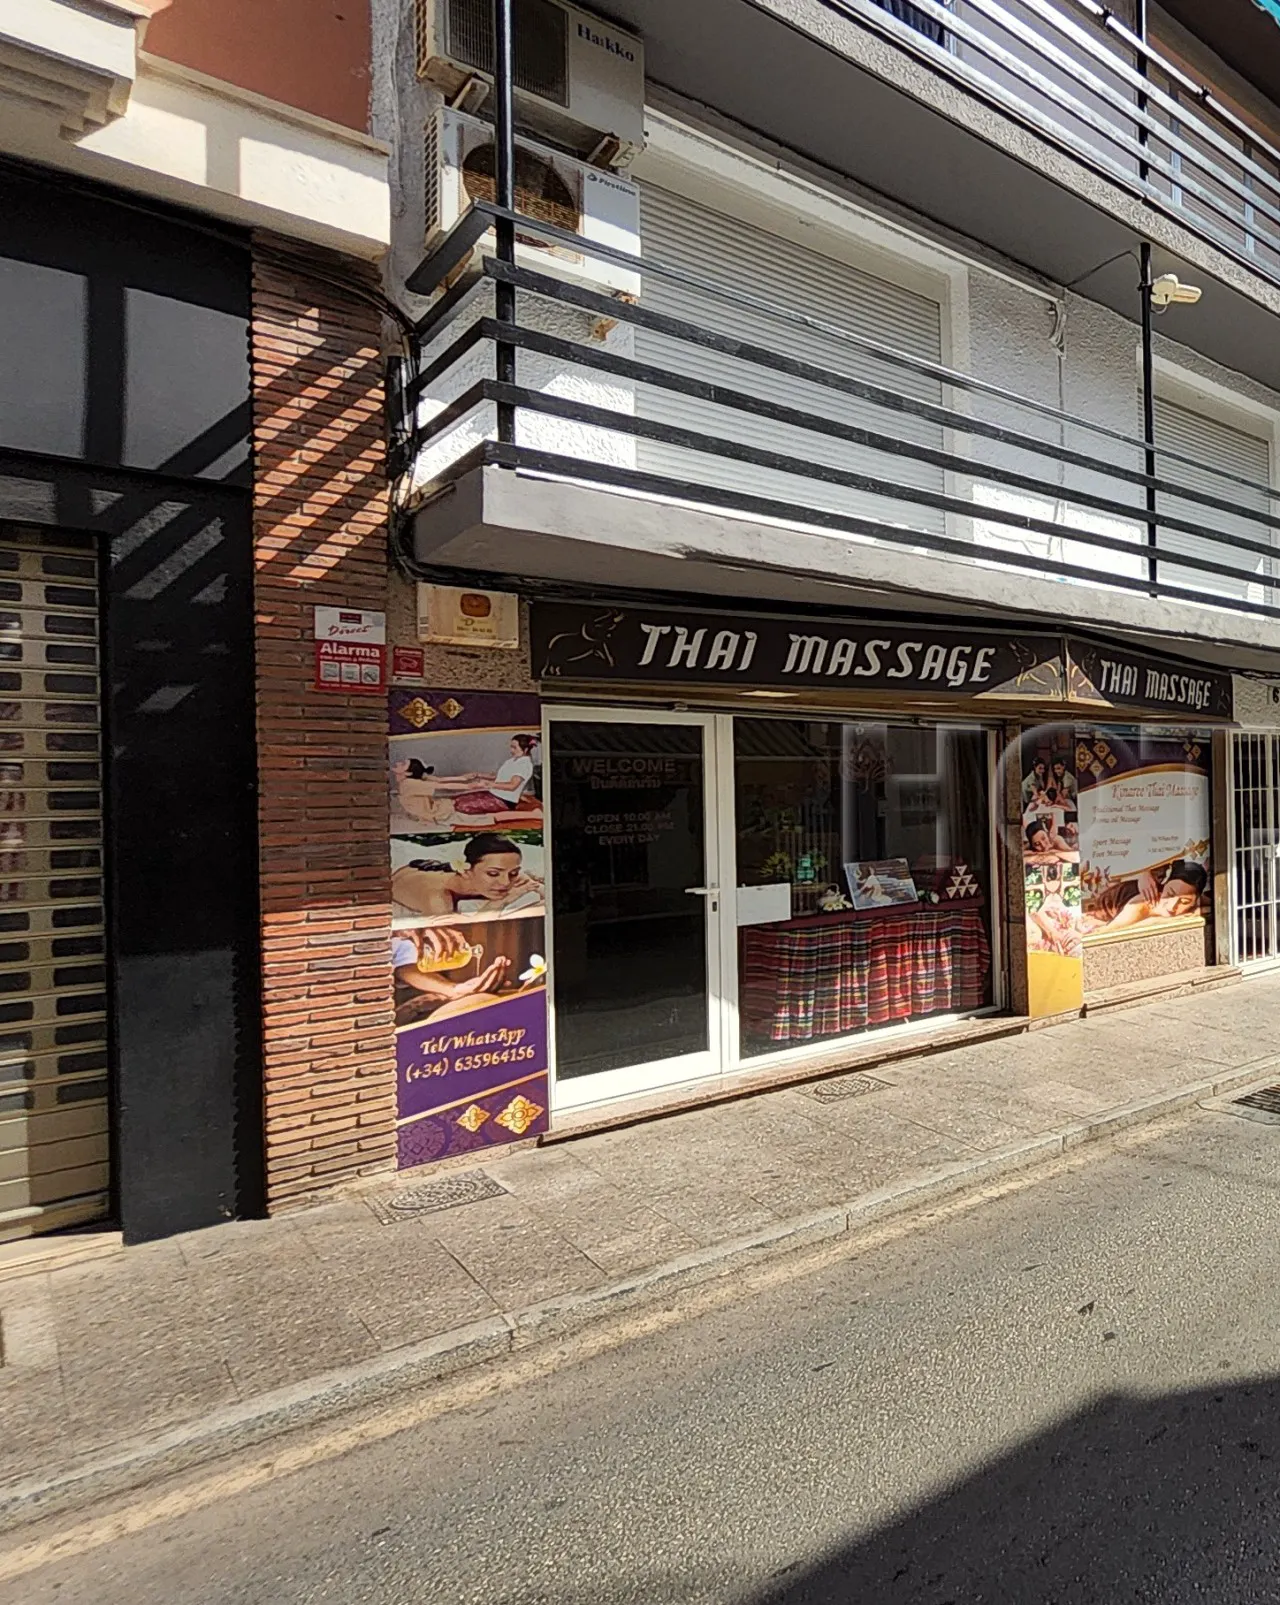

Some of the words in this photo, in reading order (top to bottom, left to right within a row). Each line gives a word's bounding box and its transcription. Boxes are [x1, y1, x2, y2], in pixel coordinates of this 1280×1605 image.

[319, 642, 381, 659] Alarma
[636, 622, 758, 672] THAI
[781, 632, 996, 687] MASSAGE
[1100, 658, 1138, 697] THAI
[1145, 668, 1212, 710] MASSAGE
[1271, 687, 1280, 704] 6
[572, 758, 677, 774] WELCOME
[587, 813, 620, 823] OPEN
[584, 823, 623, 835] CLOSE
[599, 835, 634, 846] EVERY
[638, 833, 660, 844] DAY
[419, 1027, 526, 1055] Tel/WhatsApp
[405, 1057, 449, 1083] (+34)
[454, 1044, 536, 1072] 635964156
